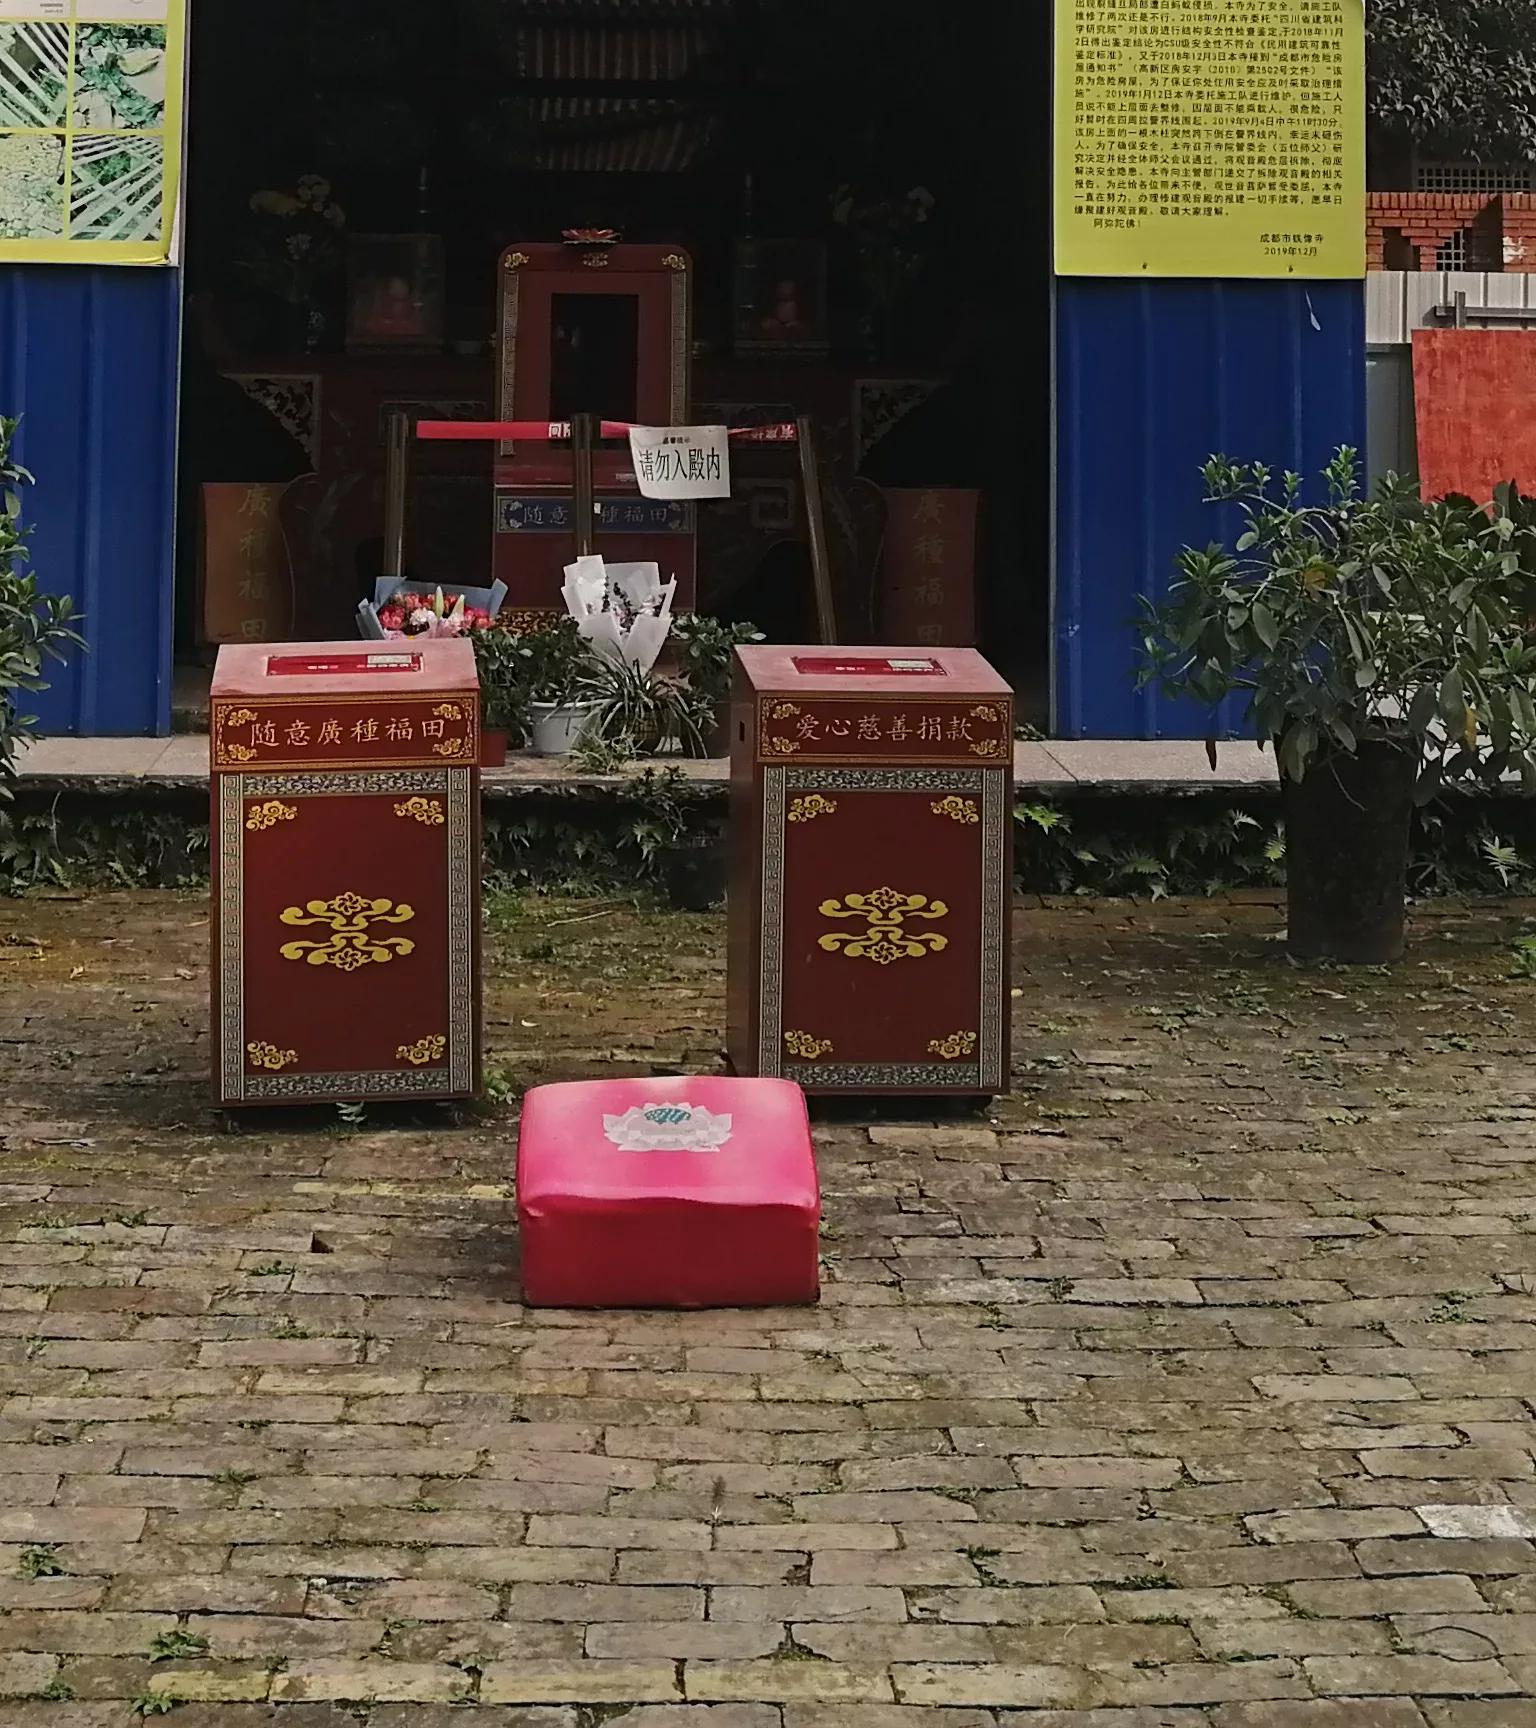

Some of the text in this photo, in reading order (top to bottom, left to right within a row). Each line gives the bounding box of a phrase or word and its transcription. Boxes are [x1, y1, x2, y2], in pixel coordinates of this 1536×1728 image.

[1264, 246, 1317, 257] 2019年12月
[639, 447, 721, 482] 请勿入殿内
[250, 717, 445, 747] 随意廣種福田
[795, 713, 975, 742] 爱心慈善捐款
